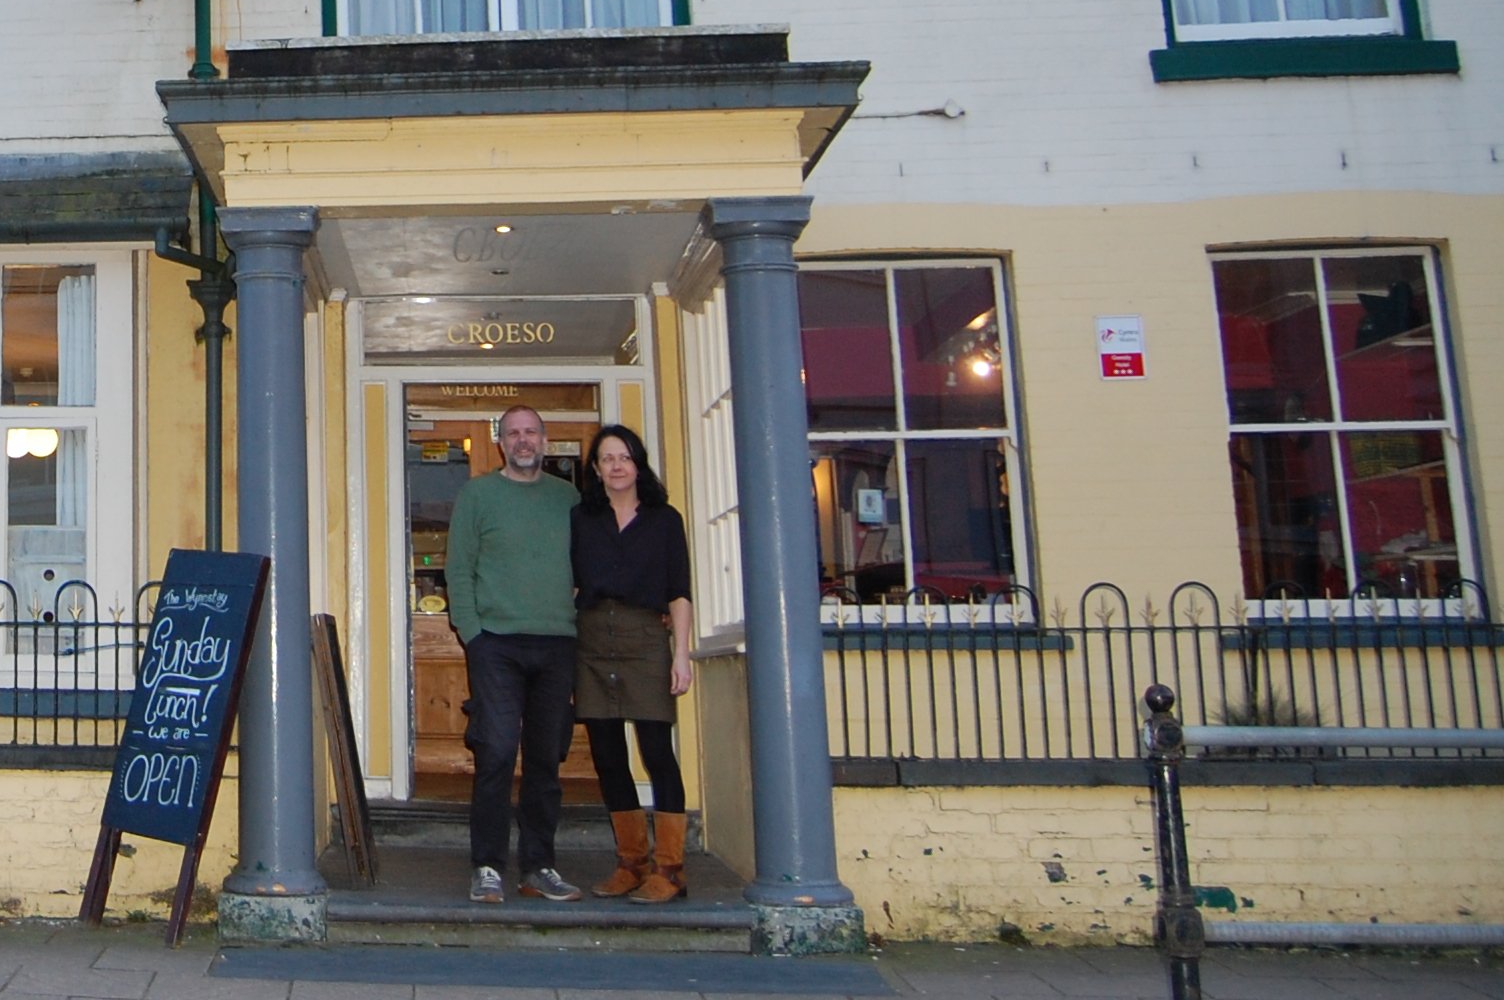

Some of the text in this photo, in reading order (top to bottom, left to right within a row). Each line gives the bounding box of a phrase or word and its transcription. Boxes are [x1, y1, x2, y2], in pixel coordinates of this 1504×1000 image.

[447, 322, 555, 344] CROESO
[441, 385, 519, 397] WELCOME
[163, 588, 180, 605] The
[142, 616, 231, 687] Sunday
[172, 727, 190, 740] are
[124, 753, 198, 808] OPEN
